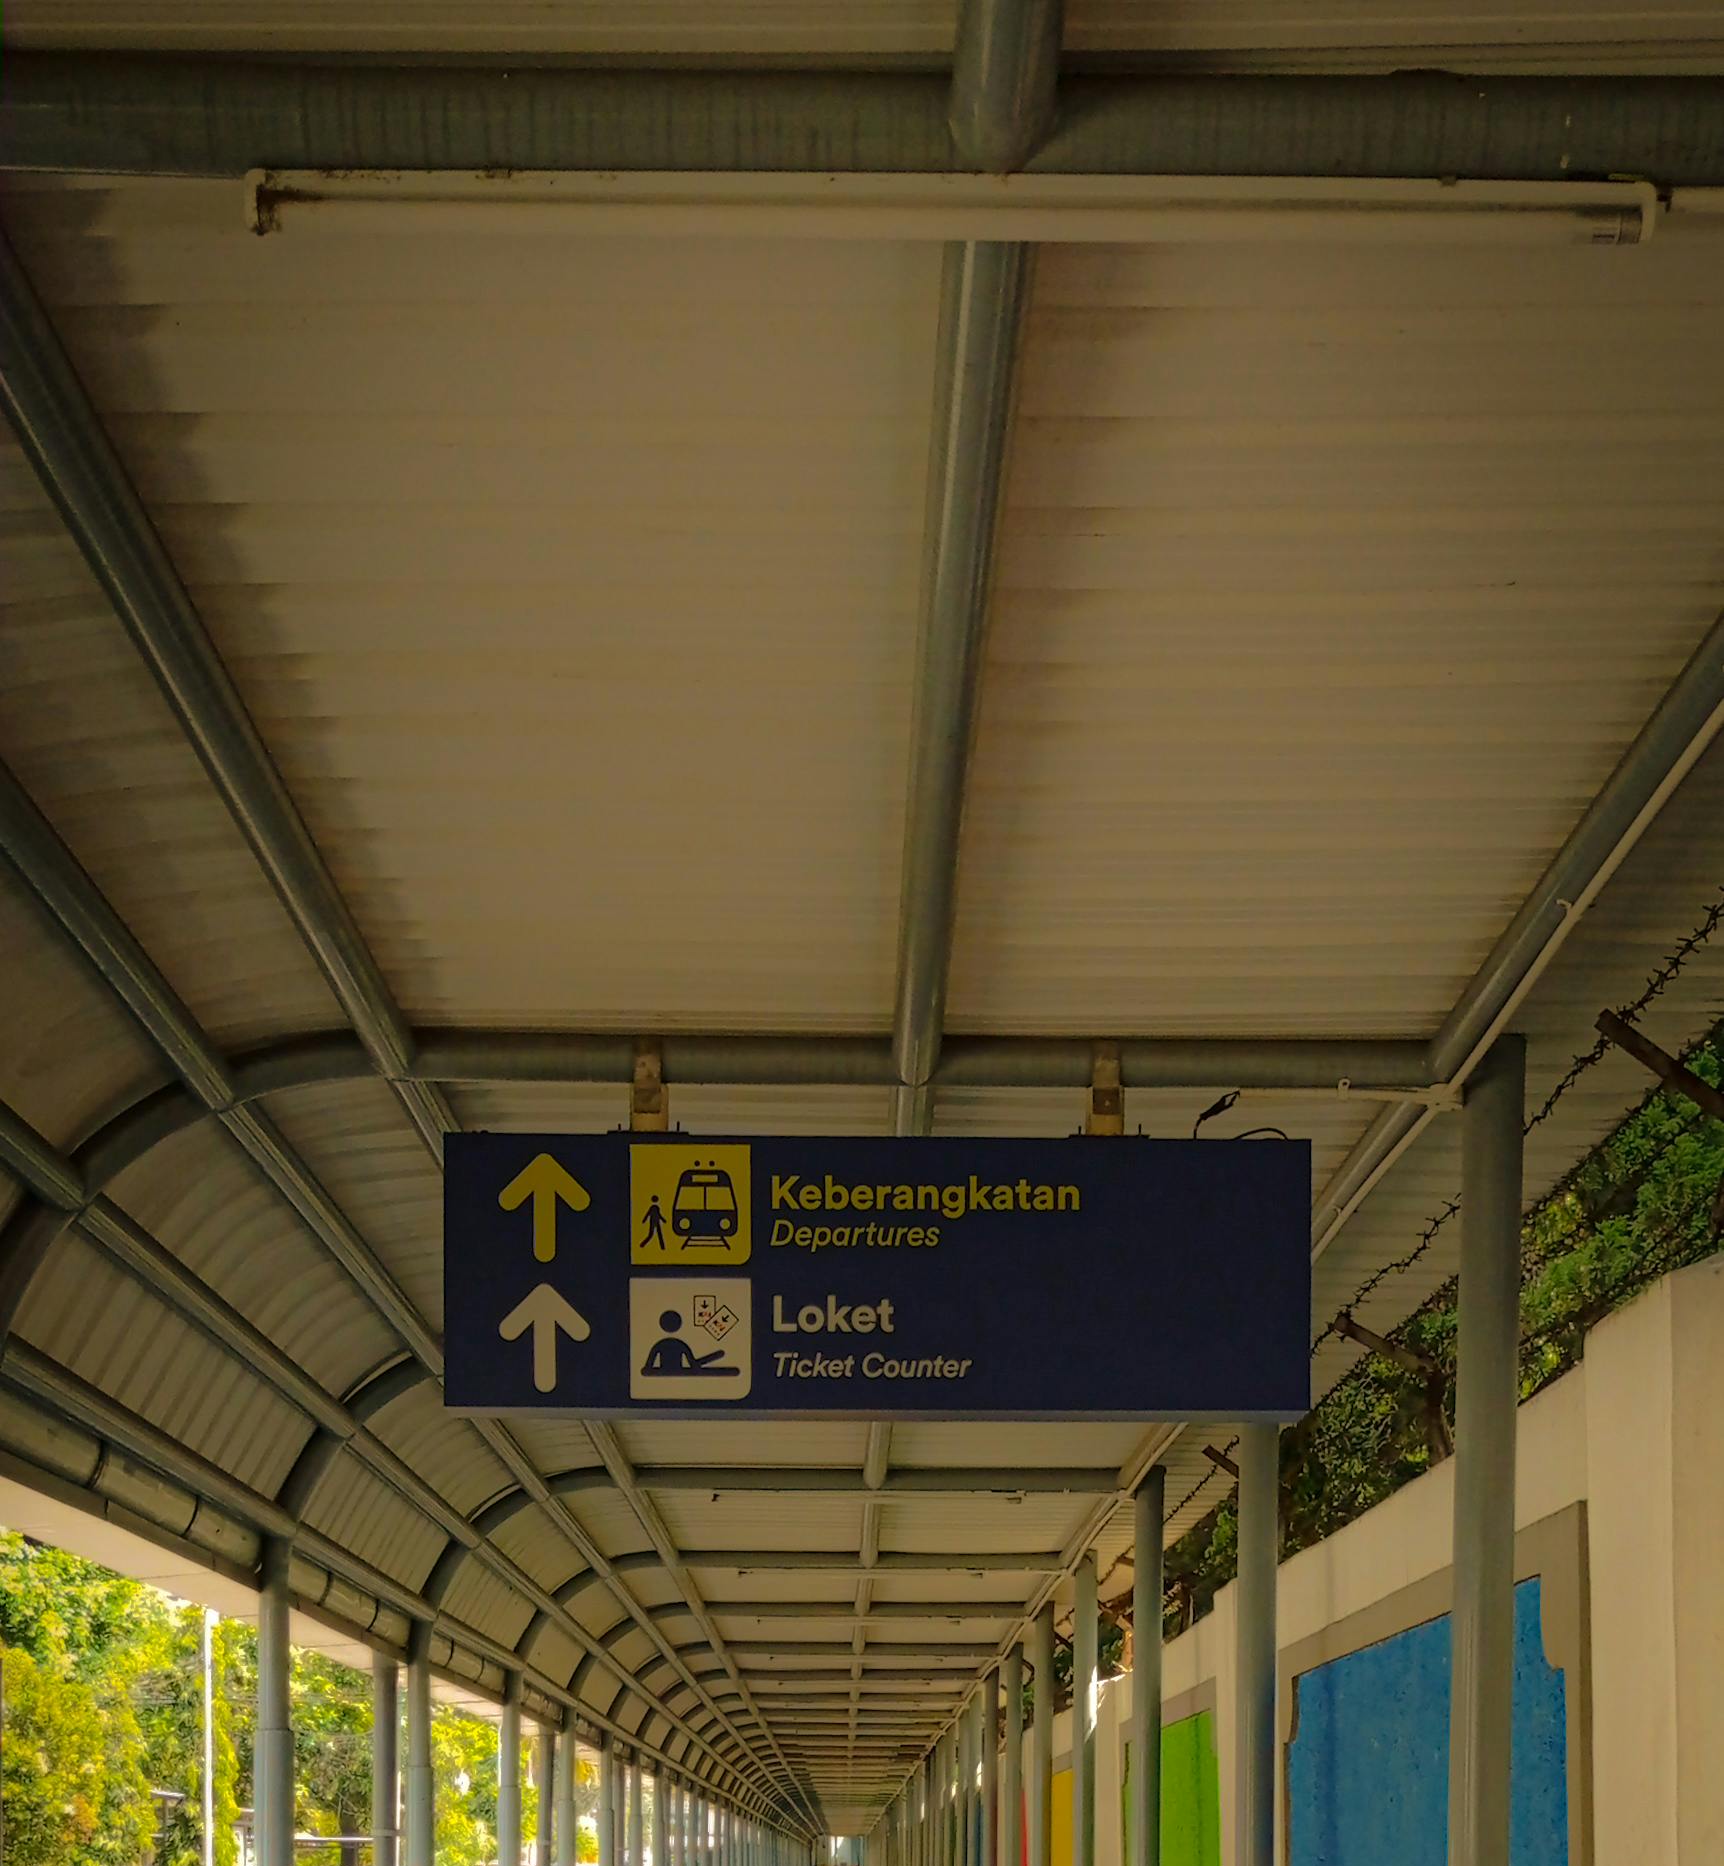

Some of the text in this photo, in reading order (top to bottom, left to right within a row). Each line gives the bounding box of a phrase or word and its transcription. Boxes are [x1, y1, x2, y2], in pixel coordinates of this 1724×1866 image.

[771, 1175, 1080, 1219] Keberangkatan
[770, 1220, 940, 1252] Departures
[772, 1294, 894, 1333] Loket
[773, 1352, 972, 1378] Ticket Counter
